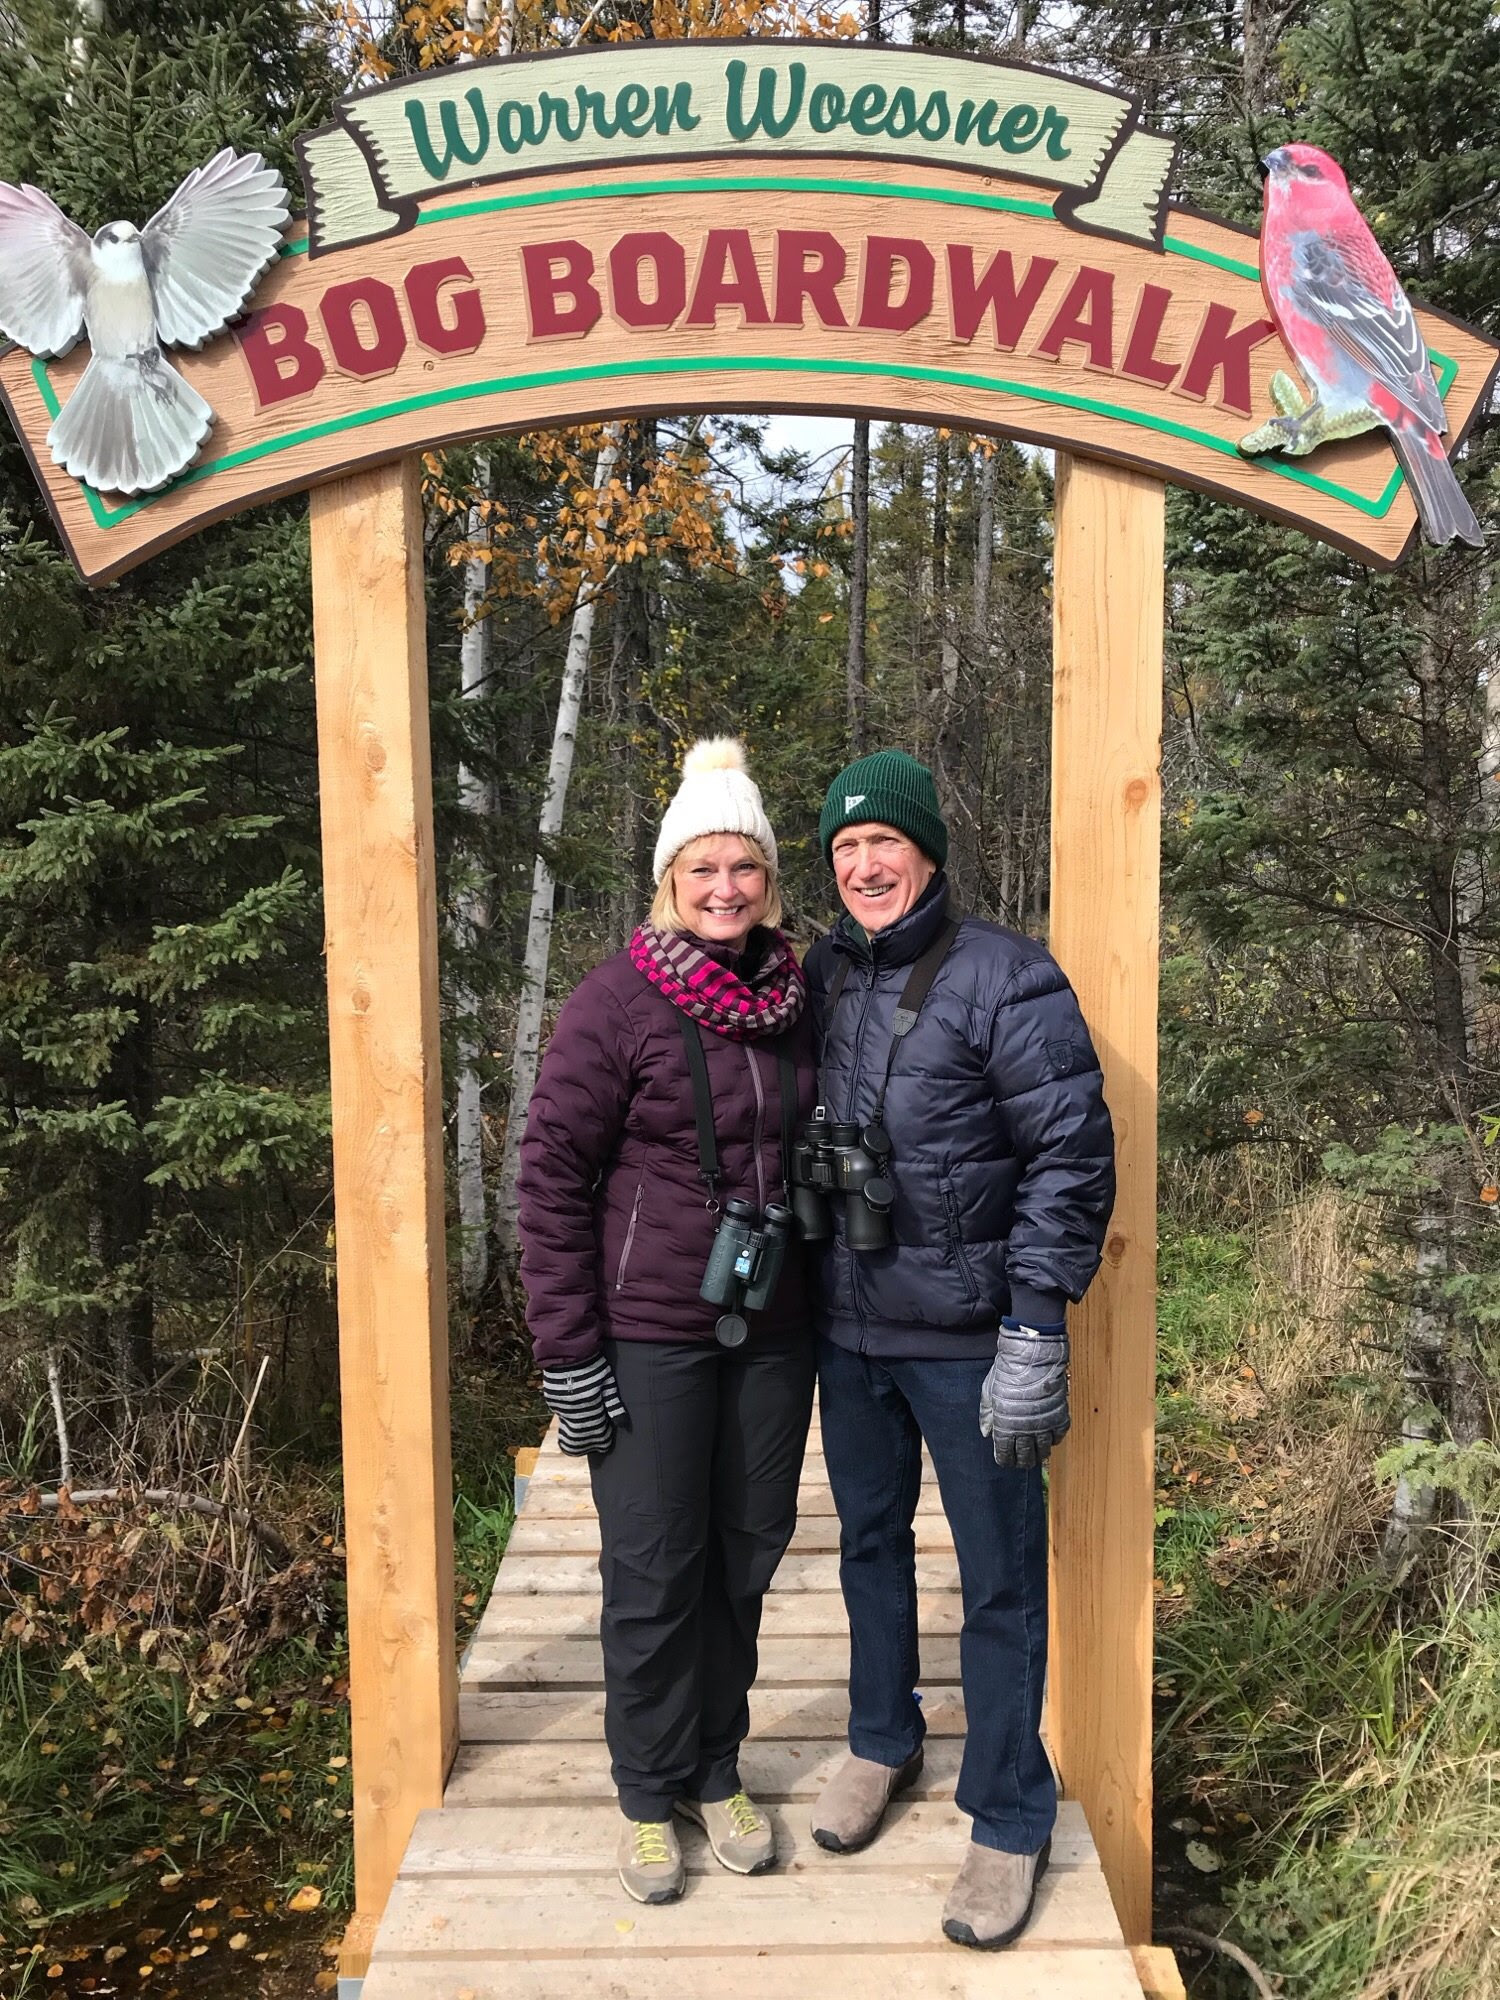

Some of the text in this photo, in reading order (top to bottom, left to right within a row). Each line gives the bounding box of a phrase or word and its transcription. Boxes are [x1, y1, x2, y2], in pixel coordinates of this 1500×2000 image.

[404, 59, 1072, 180] Warren Woessner
[231, 229, 1276, 415] BOG BOARDWALK
